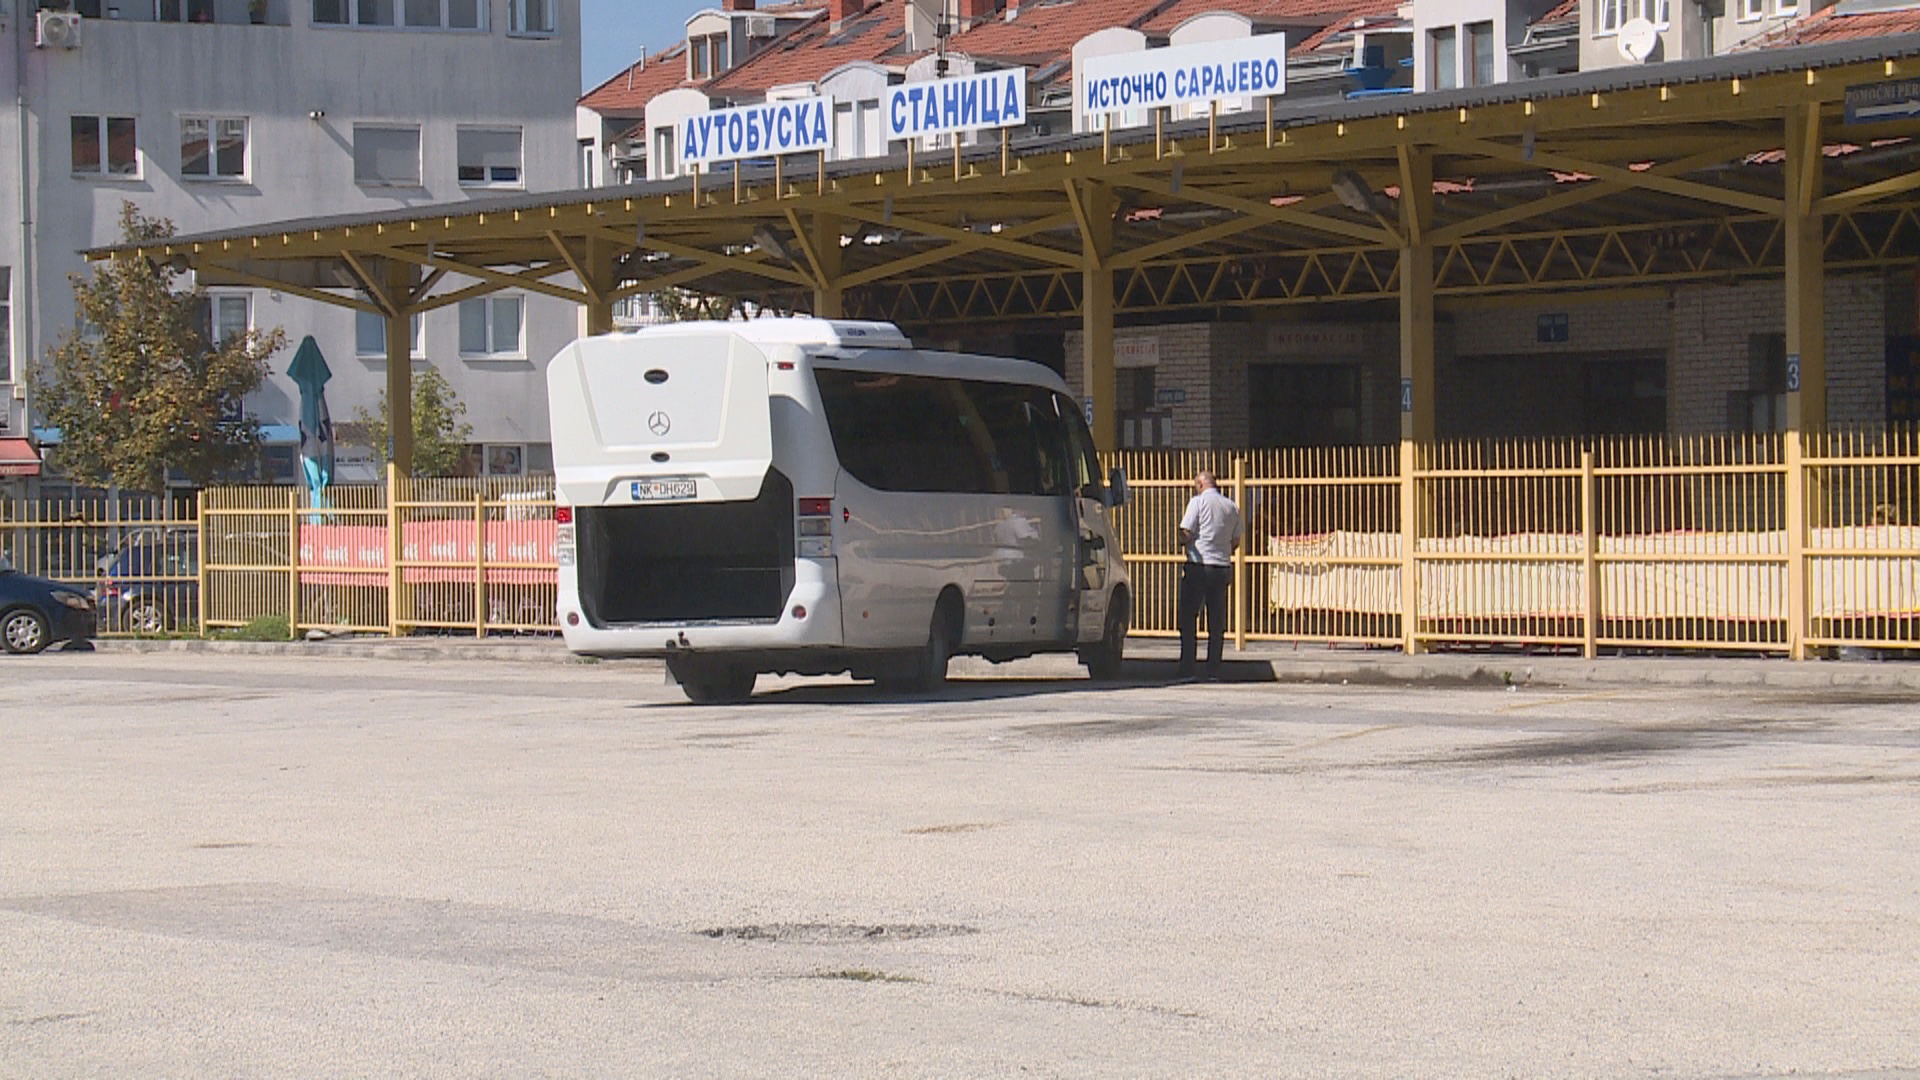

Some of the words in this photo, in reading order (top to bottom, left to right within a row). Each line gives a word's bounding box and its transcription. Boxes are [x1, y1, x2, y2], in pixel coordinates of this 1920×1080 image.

[1088, 71, 1168, 110] ИСТОЧНО
[1174, 57, 1279, 97] САРАЈЕВО
[684, 108, 828, 160] АУТОБУСКА
[891, 73, 1020, 135] СТАНИЦА
[1788, 363, 1799, 389] 3
[1402, 386, 1411, 410] 4
[1084, 403, 1093, 426] 5
